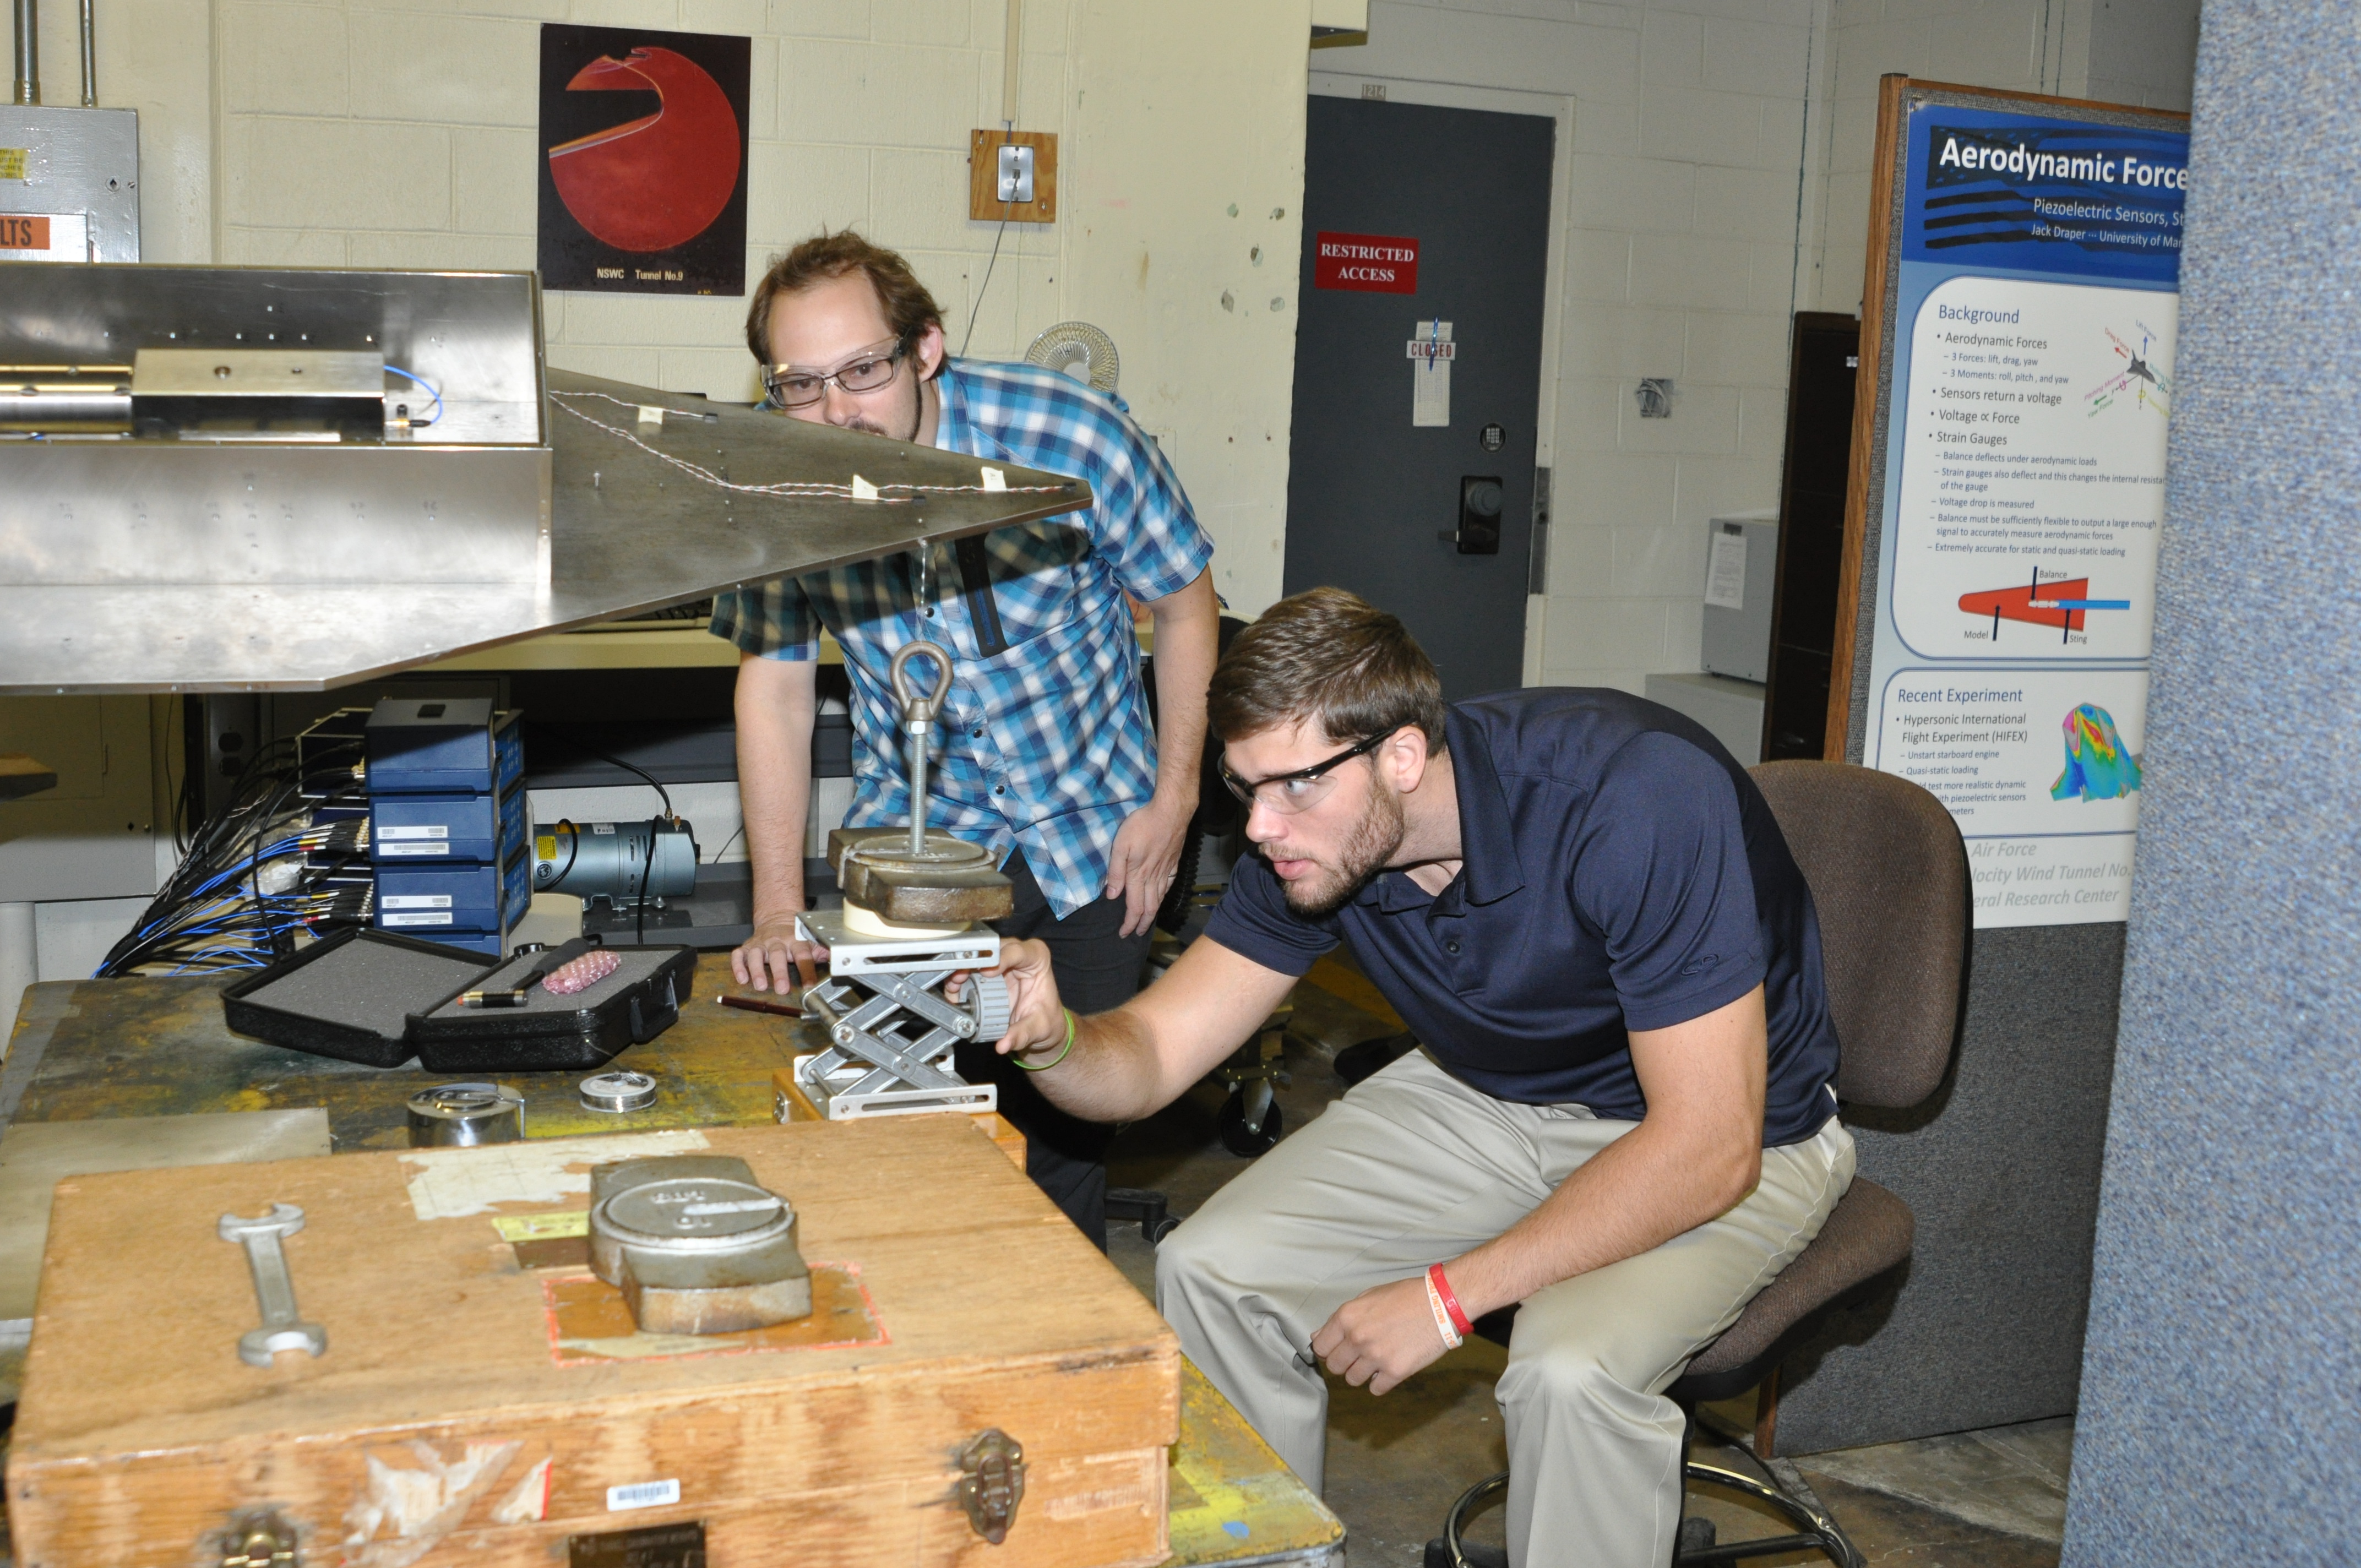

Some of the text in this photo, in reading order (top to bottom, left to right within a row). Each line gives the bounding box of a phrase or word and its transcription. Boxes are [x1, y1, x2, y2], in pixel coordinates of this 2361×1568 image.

[1939, 137, 2189, 190] Aerodynamic Force
[2034, 198, 2112, 220] Piezoelectric
[2115, 207, 2168, 227] Sensors,
[2032, 224, 2051, 237] Jack
[2054, 226, 2086, 241] Draper
[2100, 231, 2147, 247] University
[2150, 235, 2160, 246] of
[1322, 244, 1414, 262] RESTRICTED
[597, 268, 683, 281] NSWC Tunnel No.9
[1339, 267, 1394, 281] ACCESS
[1939, 305, 2019, 324] Background
[1945, 333, 2047, 349] Aerodynamic Forces
[2105, 328, 2130, 352] Drag Force
[2144, 327, 2157, 341] Force
[1952, 352, 1956, 361] 3
[1959, 353, 1985, 362] Forces:
[1988, 355, 2000, 364] lift,
[2003, 356, 2021, 367] drag,
[1951, 369, 1955, 377] 3
[1958, 369, 1996, 379] Moments:
[1999, 372, 2012, 382] roll,
[2015, 373, 2033, 383] pitch
[2039, 374, 2053, 383] and
[1941, 387, 1980, 400] Sensors
[1984, 391, 2015, 401] return
[2027, 392, 2061, 406] voltage
[1939, 410, 1977, 424] Voltage
[1993, 412, 2020, 424] Force
[1937, 432, 2007, 447] Strain Gauges
[1944, 451, 2097, 466] Balance deflects under aerodynamic loads
[1942, 468, 1963, 476] Strain
[1966, 471, 1992, 479] gauges
[1994, 470, 2009, 478] also
[2011, 470, 2036, 480] deflect
[2038, 472, 2052, 480] and
[2054, 472, 2066, 481] this
[2069, 473, 2097, 483] changes
[2099, 474, 2110, 482] the
[2112, 475, 2139, 483] internal
[1941, 481, 1988, 493] of the gauge
[1940, 498, 1968, 508] Voltage
[1970, 498, 1988, 508] drop
[1998, 500, 2034, 509] measured
[1938, 514, 1967, 522] Balance
[1991, 515, 2000, 524] be
[2002, 515, 2042, 526] sufficiently
[2044, 516, 2070, 526] flexible
[2081, 519, 2104, 527] output
[2113, 519, 2129, 529] large
[2131, 520, 2157, 531] enough
[1937, 527, 1959, 537] signal
[1971, 529, 2009, 538] accurately
[2044, 531, 2090, 540] aerodynamic
[2092, 531, 2113, 540] forces
[1935, 543, 1973, 553] Extremely
[2009, 545, 2020, 553] for
[2058, 547, 2098, 556] quasi-static
[2100, 547, 2125, 558] loading
[2039, 570, 2068, 579] Balance
[1964, 630, 1988, 639] Model
[2069, 635, 2087, 645] Sting
[1898, 688, 2022, 705] Recent Experiment
[1905, 714, 2026, 727] Hypersonic International
[1903, 731, 2027, 745] Flight Experiment (HIFEX)
[1938, 750, 1973, 759] starboard
[1974, 750, 1999, 760] engine
[1906, 766, 1978, 775] Quasi-static loading
[1966, 781, 1993, 789] realistic
[1995, 780, 2026, 790] dynamic
[1951, 793, 1996, 804] piezoelectric
[1971, 842, 2037, 857] Air Force
[2017, 865, 2056, 880] Wind
[2060, 864, 2106, 880] Tunnel
[2108, 864, 2131, 878] No.
[2005, 890, 2070, 906] Research
[2074, 889, 2119, 903] Center
